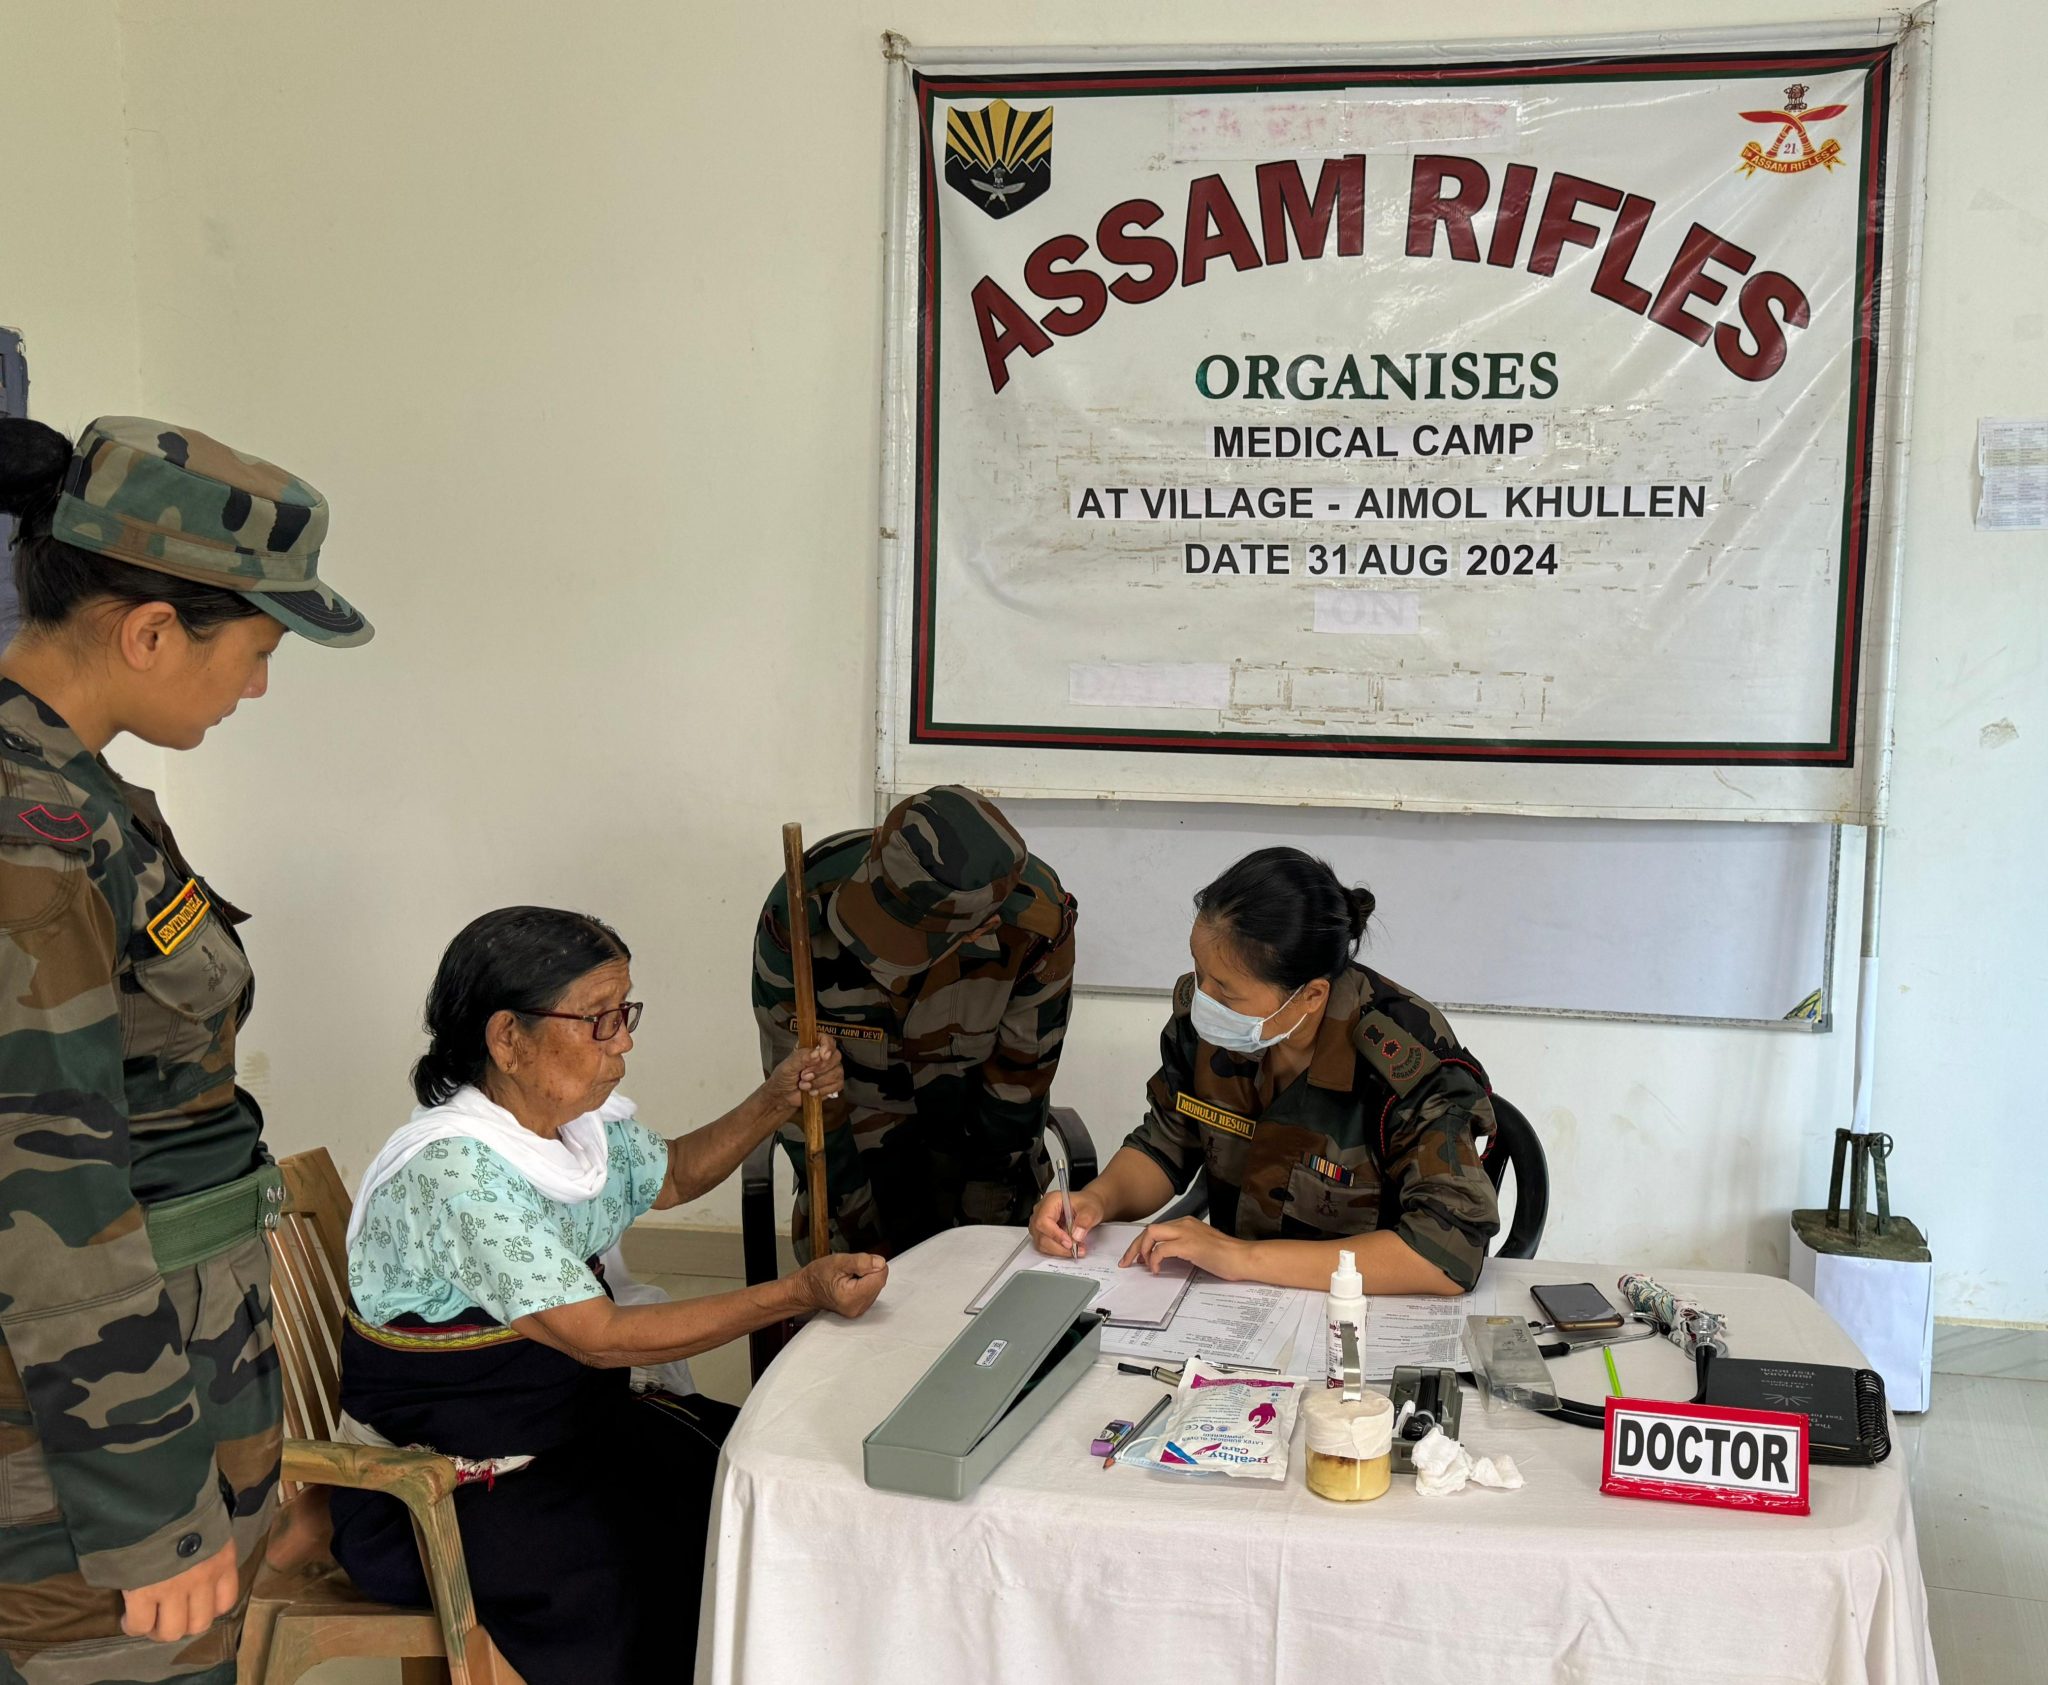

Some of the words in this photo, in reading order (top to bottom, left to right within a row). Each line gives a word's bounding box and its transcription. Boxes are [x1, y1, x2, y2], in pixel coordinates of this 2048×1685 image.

[1751, 155, 1788, 172] ASSAM
[1790, 152, 1829, 173] RIFLES
[1784, 143, 1796, 154] 21
[971, 154, 1366, 394] ASSAM
[1405, 154, 1811, 382] RIFLES
[1195, 351, 1559, 401] ORGANISES
[1213, 426, 1399, 458] MEDICAL
[1412, 423, 1535, 456] CAMP
[1077, 487, 1129, 519] AT
[1140, 487, 1313, 519] VILLAGE
[1354, 487, 1487, 519] AIMOL
[1505, 485, 1706, 518] KHULLEN
[1185, 543, 1290, 575] DATE
[1308, 544, 1347, 575] 31
[1358, 544, 1449, 576] AUG
[1466, 543, 1558, 576] 2024
[863, 1030, 881, 1039] DEVI
[1208, 1449, 1269, 1464] Healthy
[1221, 1445, 1249, 1454] Care
[1618, 1418, 1789, 1484] DOCTOR
